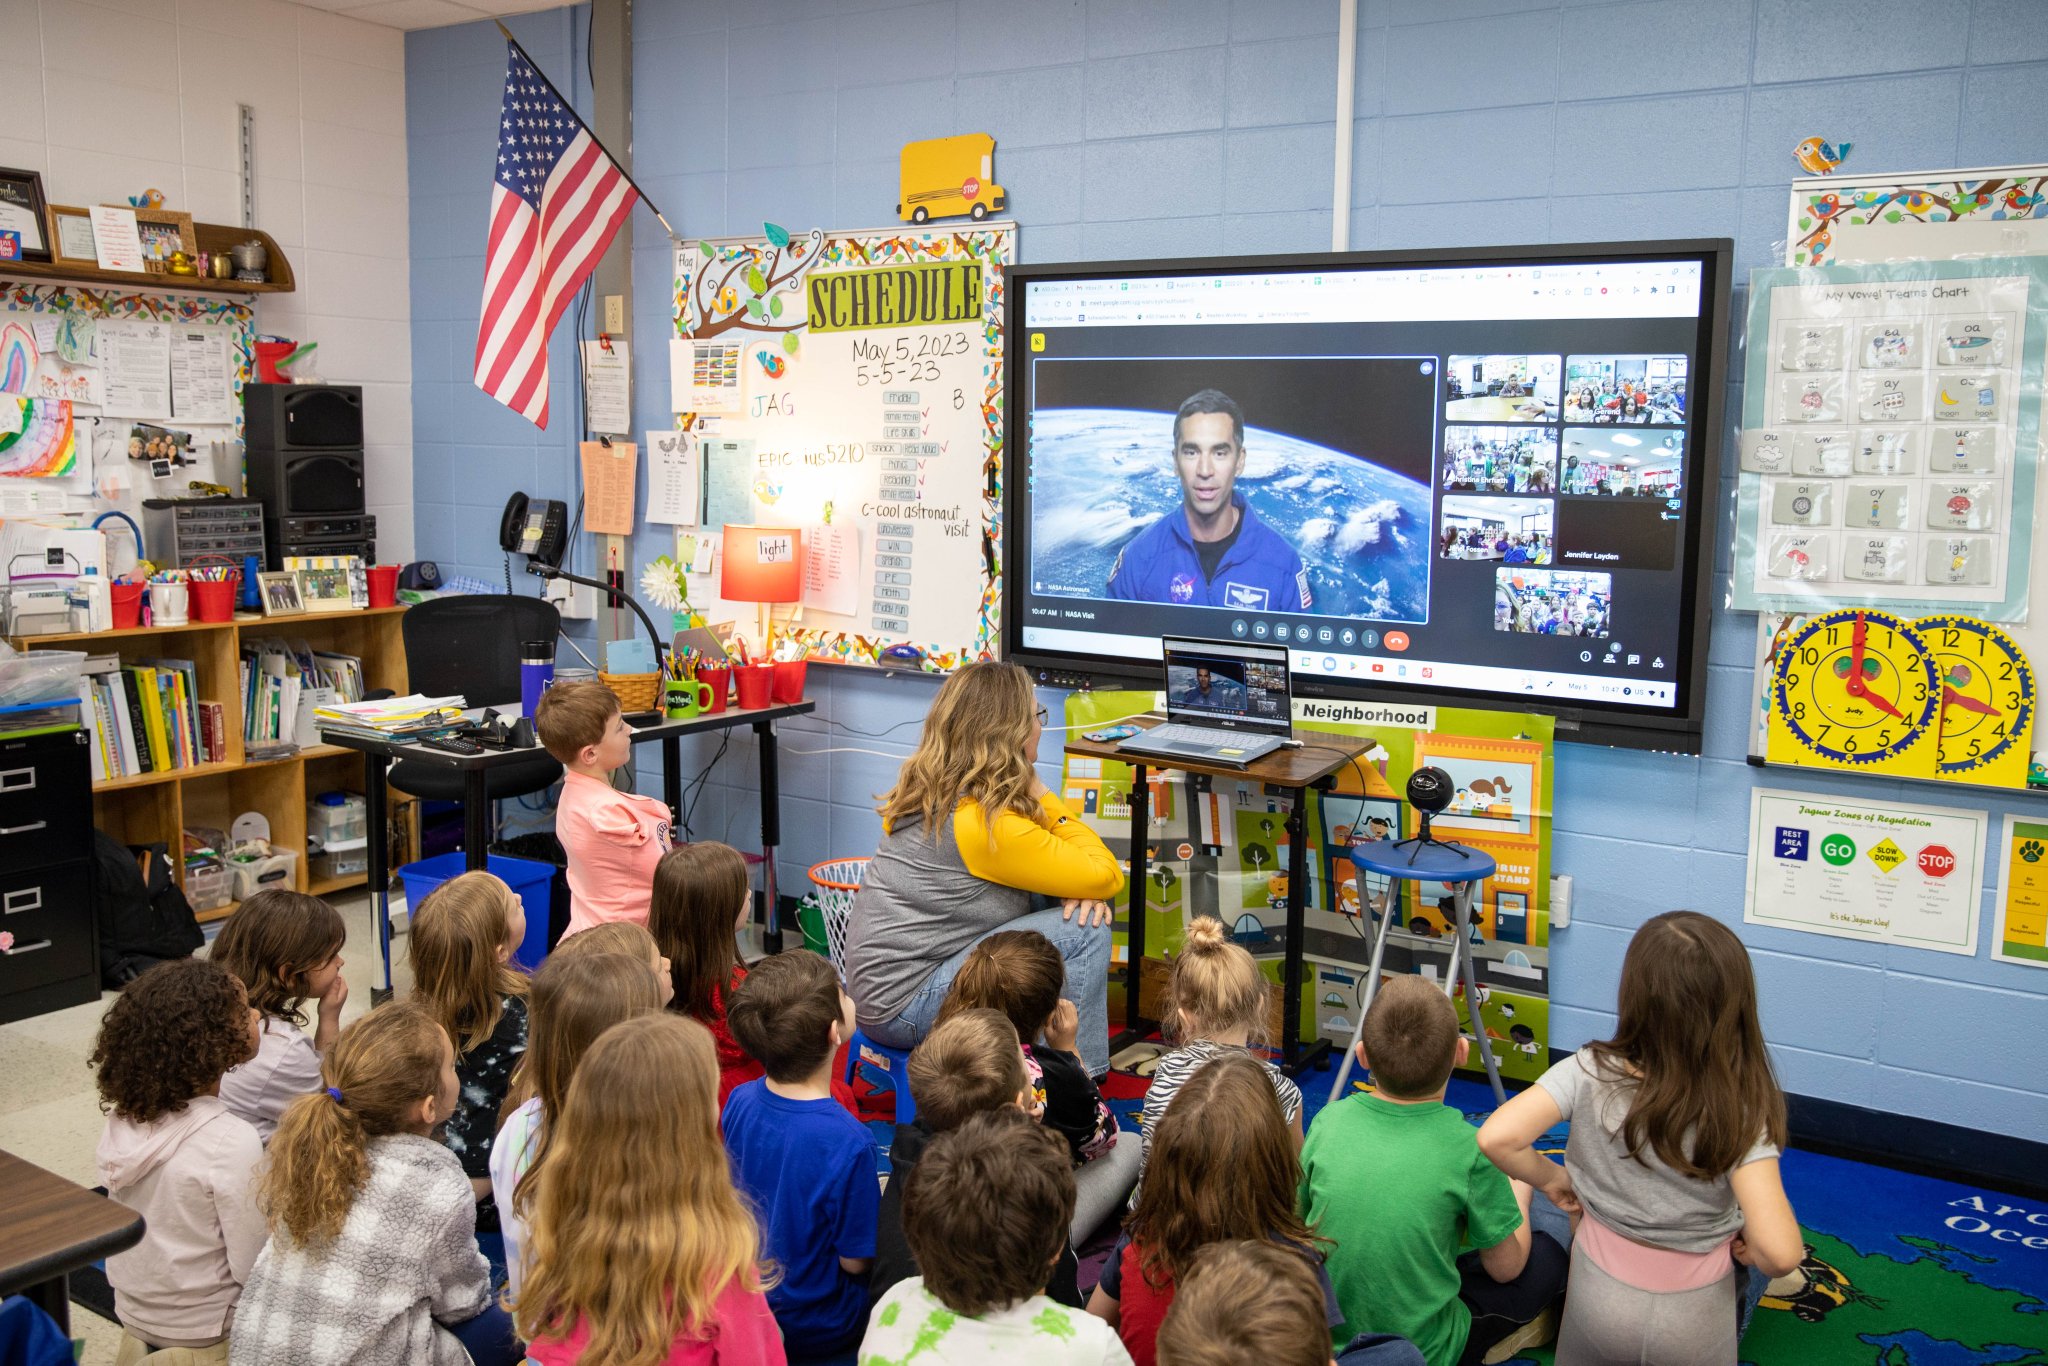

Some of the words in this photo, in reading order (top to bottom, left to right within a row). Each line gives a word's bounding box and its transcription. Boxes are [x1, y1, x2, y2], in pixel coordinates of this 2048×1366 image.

[963, 184, 978, 194] STOP
[811, 266, 982, 329] SCHEDULE
[1826, 291, 1843, 302] My
[1850, 289, 1882, 300] Vowel
[1886, 288, 1928, 299] Teams
[1932, 286, 1970, 299] Chart
[1884, 329, 1900, 337] ea
[1964, 324, 1981, 333] oa
[853, 338, 889, 364] May
[857, 361, 942, 387] 5-5-23
[1884, 380, 1900, 390] ay
[751, 392, 795, 418] JAG
[953, 388, 965, 410] B
[758, 452, 793, 468] EPIC
[1952, 462, 1969, 470] glue
[1798, 484, 1809, 494] oi
[1870, 488, 1885, 499] oy
[861, 502, 900, 519] C-cool
[904, 502, 961, 521] astronaut
[944, 518, 971, 537] visit
[888, 541, 900, 551] WIN
[1791, 538, 1809, 546] aw
[1868, 539, 1885, 548] au
[1948, 542, 1969, 555] igh
[758, 540, 789, 563] light
[1564, 551, 1593, 559] Jennifer
[1593, 552, 1619, 561] Layden
[881, 587, 901, 598] Math
[1170, 584, 1193, 594] NASA
[1031, 607, 1047, 615] 10:47
[1065, 610, 1082, 618] NASA
[1081, 612, 1095, 620] Visit
[1502, 617, 1514, 625] You
[1826, 627, 1839, 646] 11
[1886, 630, 1893, 649] 1
[1941, 628, 1961, 648] 12
[1978, 638, 1985, 657] 1
[1799, 647, 1819, 666] 10
[1906, 653, 1920, 673] 2
[1998, 661, 2013, 681] 2
[1568, 682, 1582, 691] May
[1634, 688, 1644, 696] US
[1786, 673, 1800, 691] 9
[1913, 682, 1927, 701] 3
[2006, 691, 2020, 710] 3
[1303, 703, 1428, 725] Neighborhood
[1793, 701, 1806, 720] 8
[1845, 707, 1864, 716] Judy
[1900, 711, 1914, 730] 4
[1818, 724, 1832, 742] 7
[1991, 720, 2006, 739] 4
[1844, 734, 1858, 753] 6
[1876, 729, 1891, 748] 5
[1966, 738, 1981, 757] 5
[1798, 805, 1831, 817] Jaguar
[1833, 809, 1862, 821] Zones
[1864, 813, 1875, 823] of
[1877, 815, 1932, 828] Regulation
[1782, 829, 1802, 839] REST
[1781, 839, 1802, 847] AREA
[1824, 843, 1853, 858] GO
[1877, 846, 1898, 855] SLOW
[1875, 854, 1899, 863] DOWN!
[1918, 853, 1954, 869] STOP
[1495, 863, 1531, 875] FRUIT
[1493, 874, 1530, 885] STAND
[1830, 912, 1839, 920] It's
[1840, 913, 1850, 922] the
[1851, 914, 1873, 928] Jaguar
[1874, 917, 1890, 929] Way!
[1946, 1195, 2048, 1226] Arc
[1944, 1215, 2048, 1249] Oce
